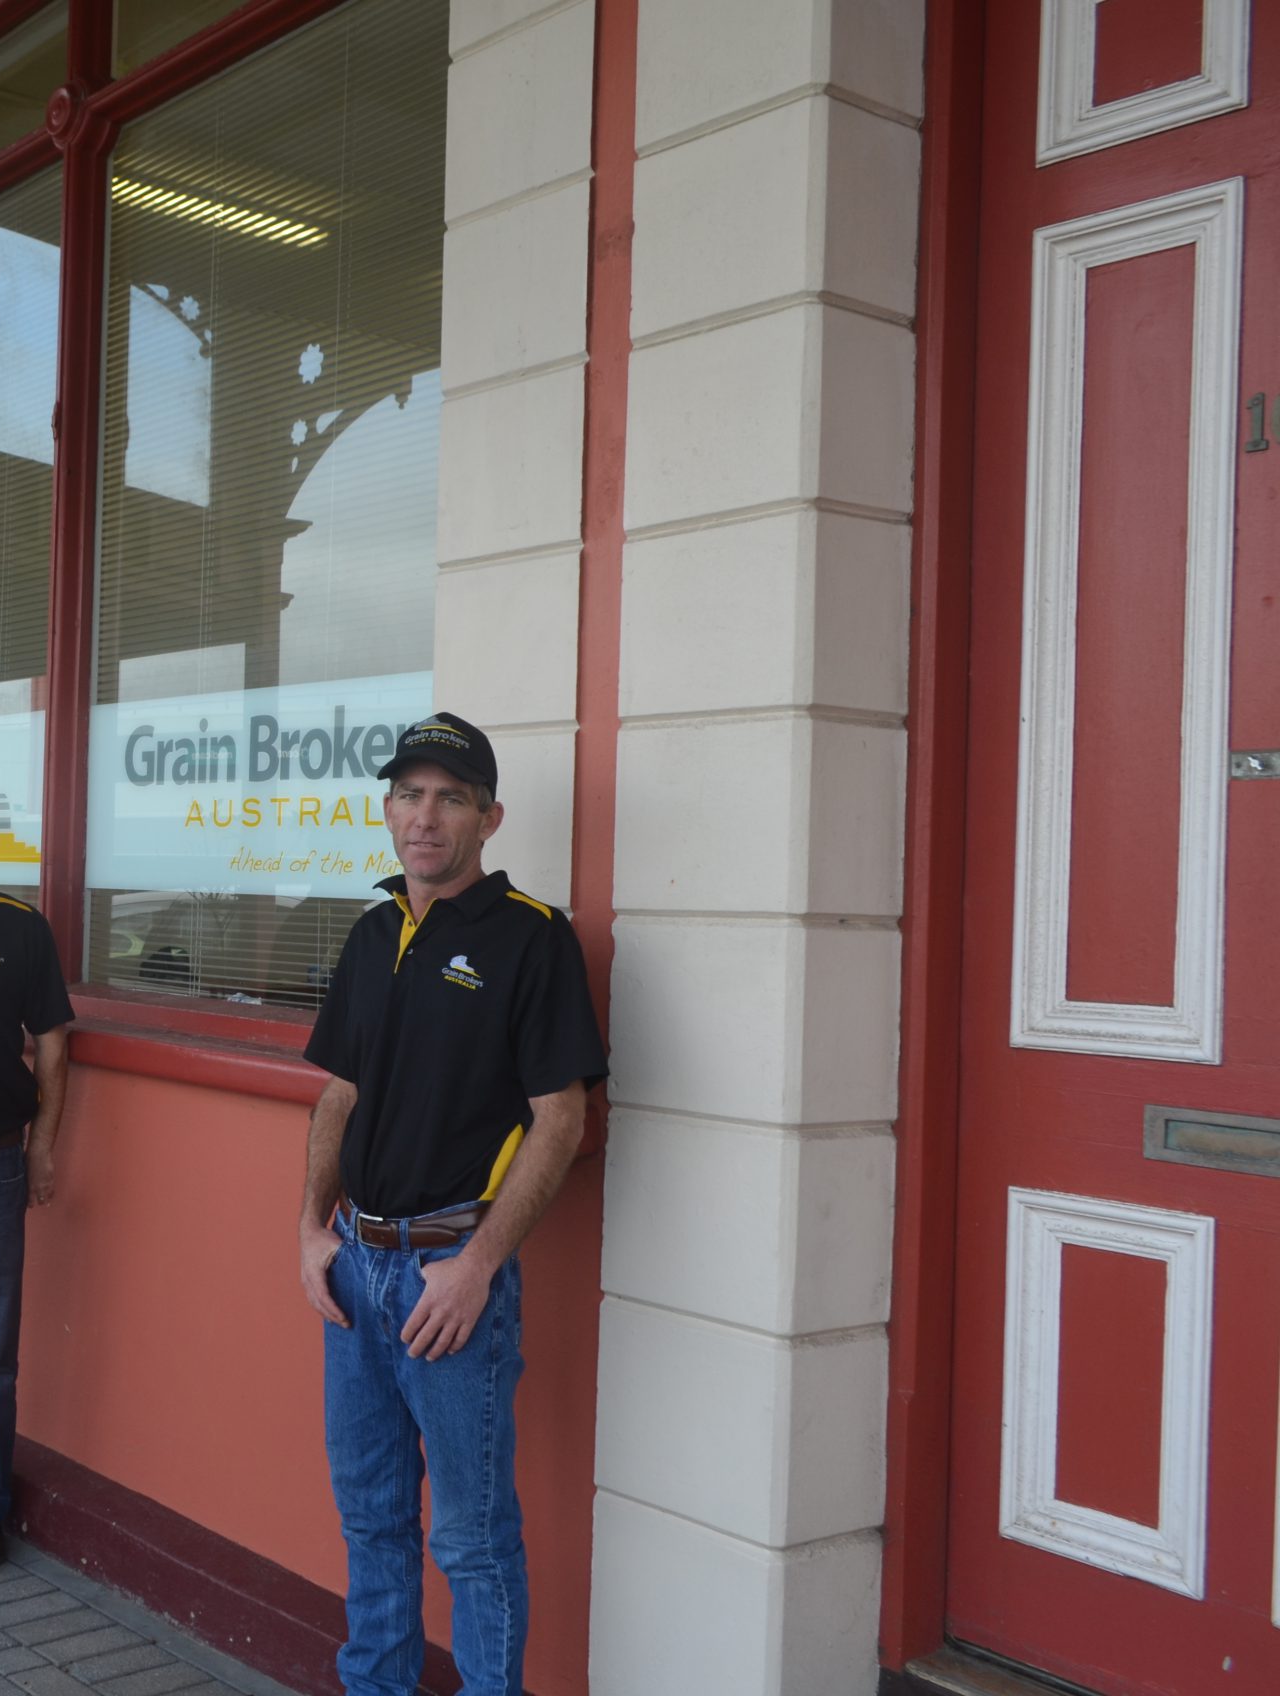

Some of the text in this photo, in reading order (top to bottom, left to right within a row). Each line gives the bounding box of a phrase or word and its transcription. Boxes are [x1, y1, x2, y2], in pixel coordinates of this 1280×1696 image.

[1244, 391, 1280, 454] 1
[124, 704, 407, 787] Grain Broke
[404, 730, 470, 749] Grain Brokers
[409, 737, 461, 749] AUSTRALIA
[184, 795, 385, 828] AUSTRAL
[230, 846, 282, 873] Ahead
[289, 850, 317, 873] of
[320, 850, 353, 874] the
